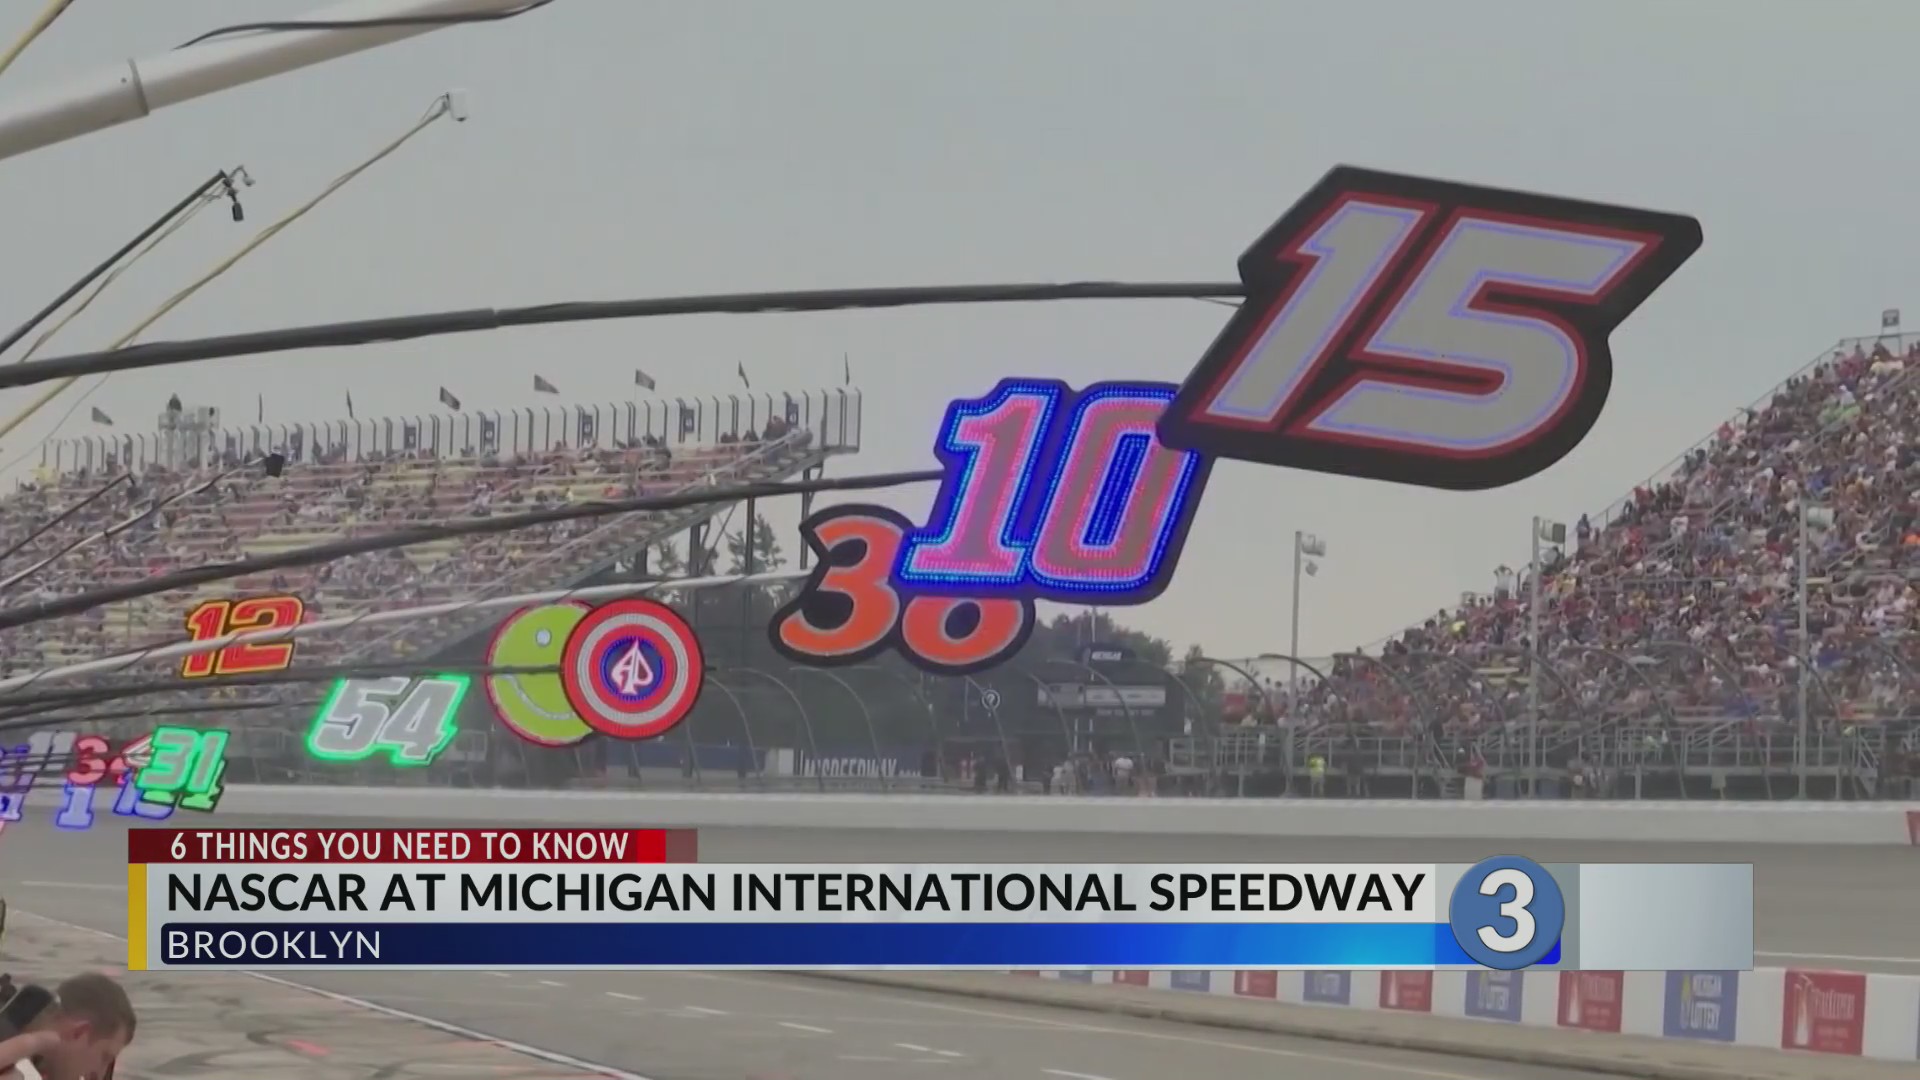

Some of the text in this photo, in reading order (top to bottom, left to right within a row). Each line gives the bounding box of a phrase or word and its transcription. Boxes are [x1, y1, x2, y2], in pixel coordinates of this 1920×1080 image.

[1190, 191, 1662, 458] 15
[903, 387, 1198, 590] 10
[183, 597, 302, 677] 12
[138, 725, 229, 793] 31
[310, 675, 468, 763] 54
